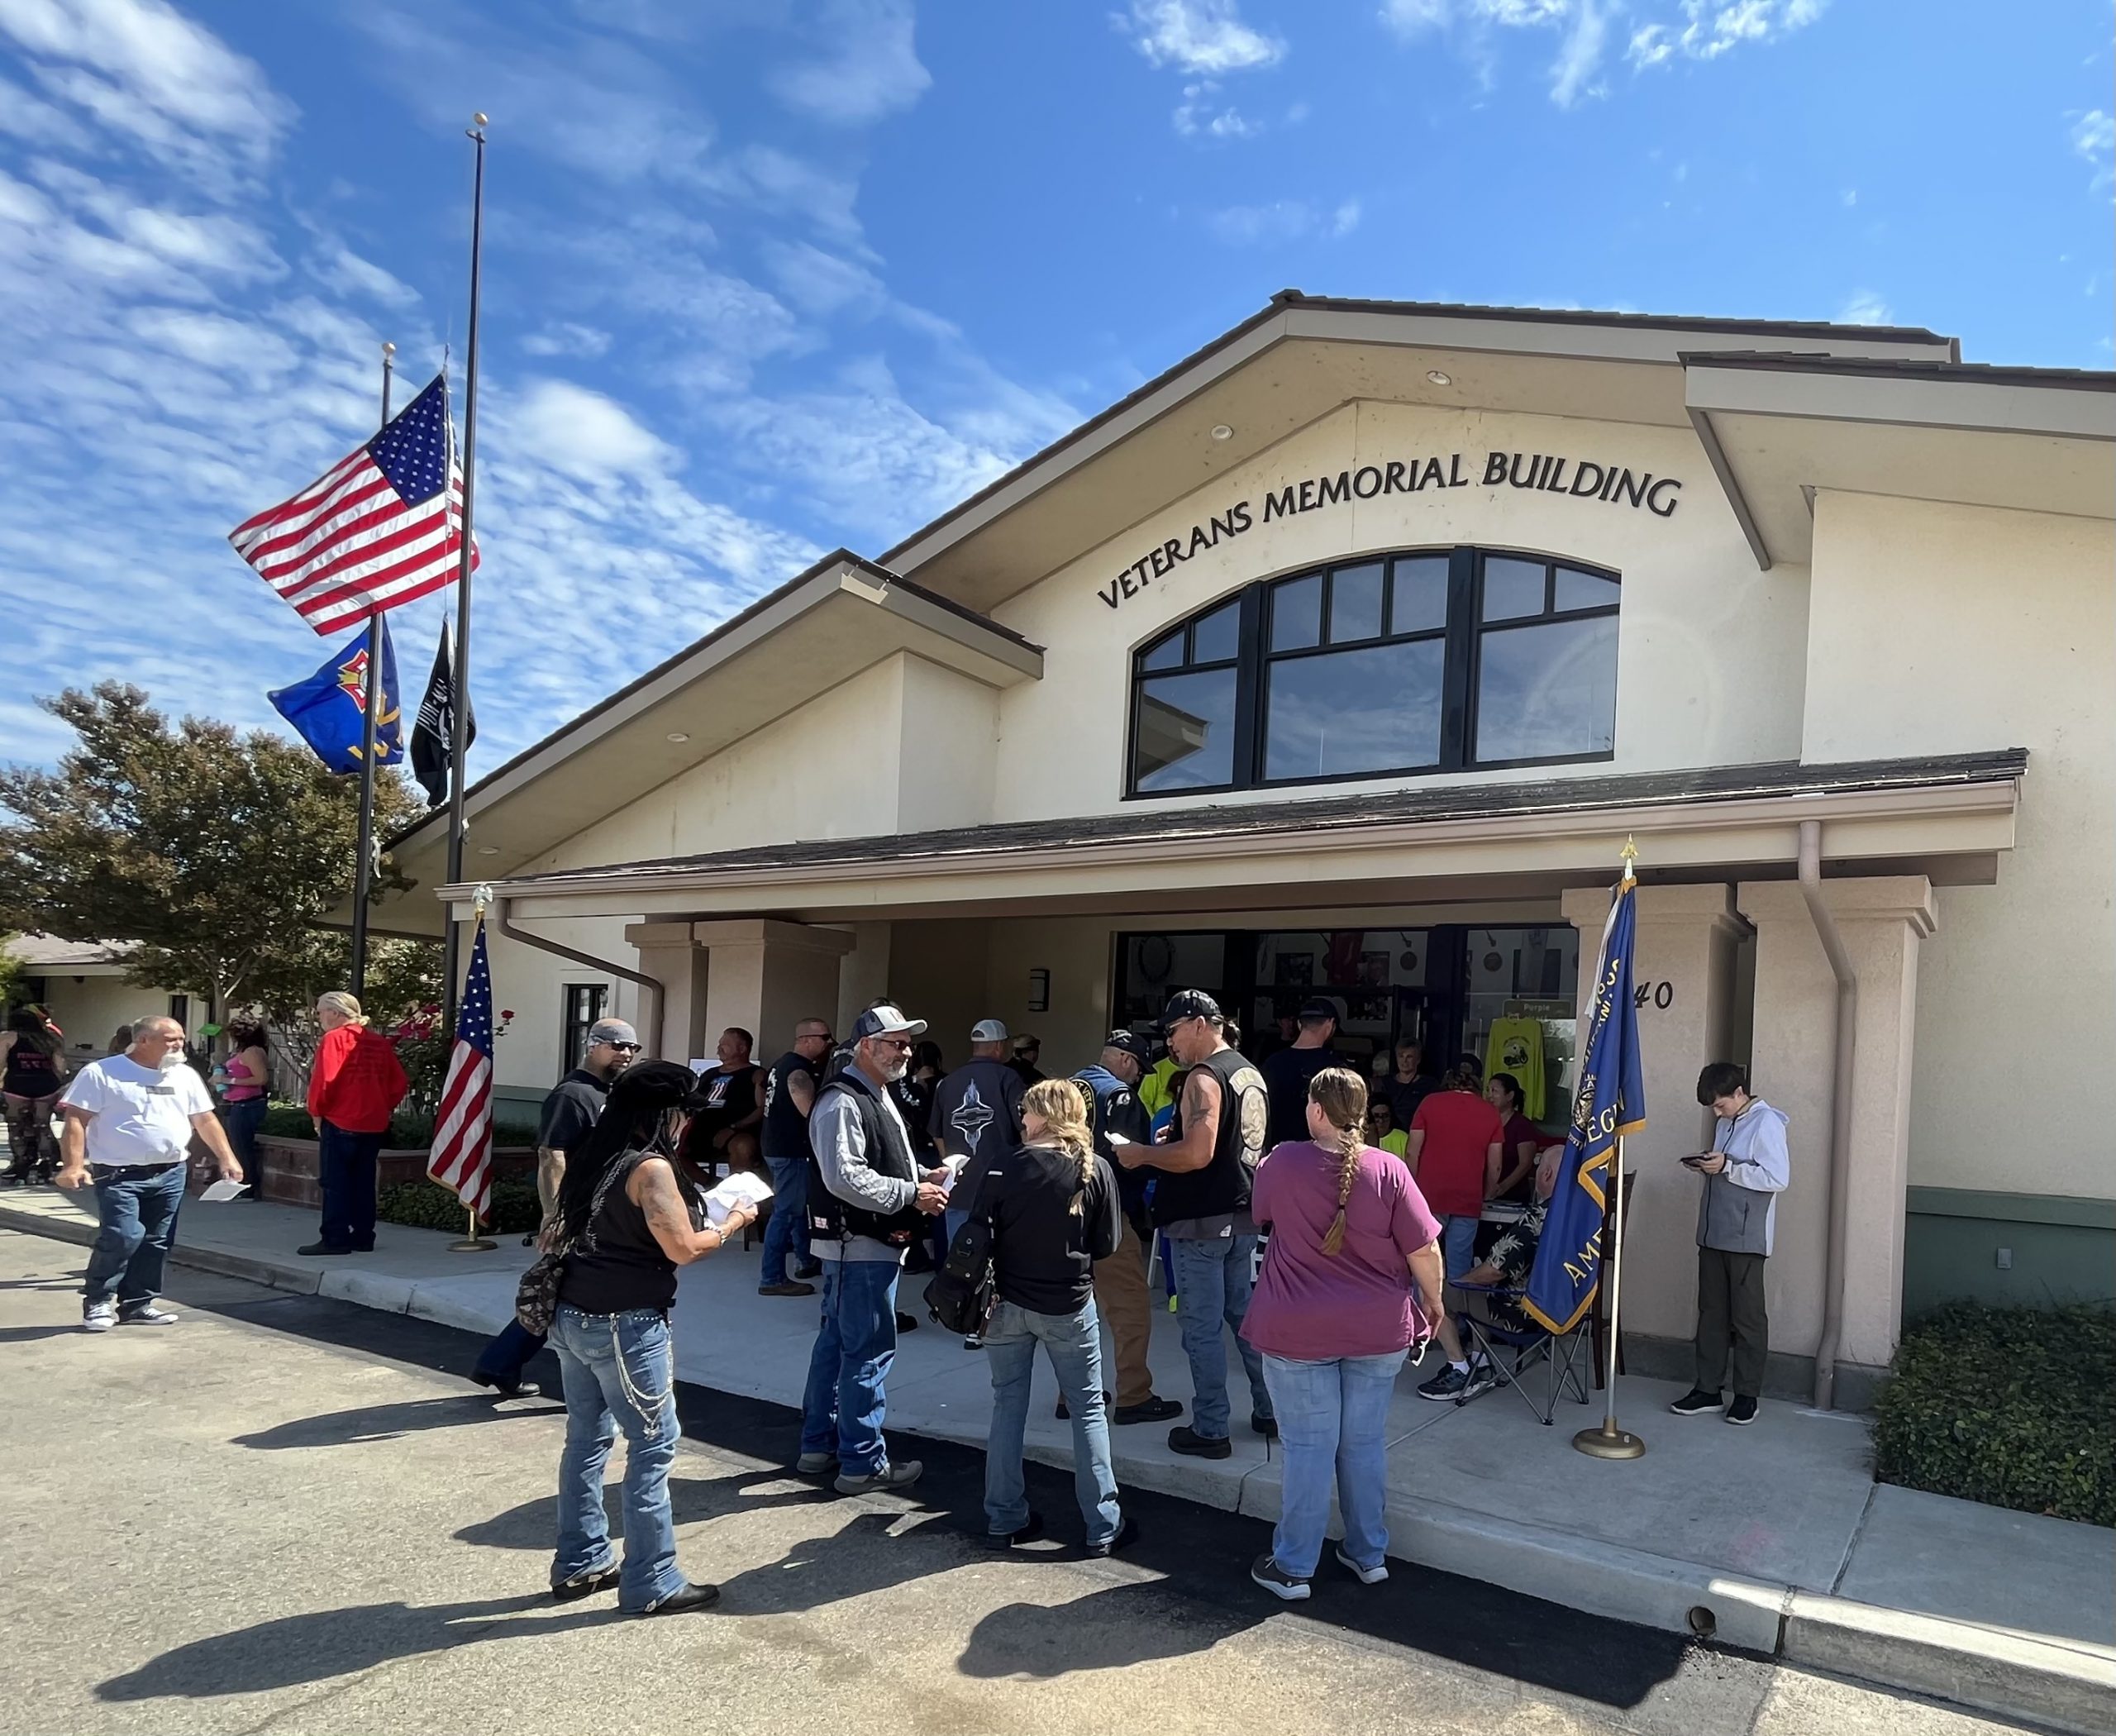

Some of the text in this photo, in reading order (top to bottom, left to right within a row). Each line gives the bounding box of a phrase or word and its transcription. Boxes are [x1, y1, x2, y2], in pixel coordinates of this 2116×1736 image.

[1098, 452, 1683, 608] VETERANS MEMORIAL BUILDING
[1523, 1003, 1551, 1012] Purple
[1634, 981, 1673, 1009] 40
